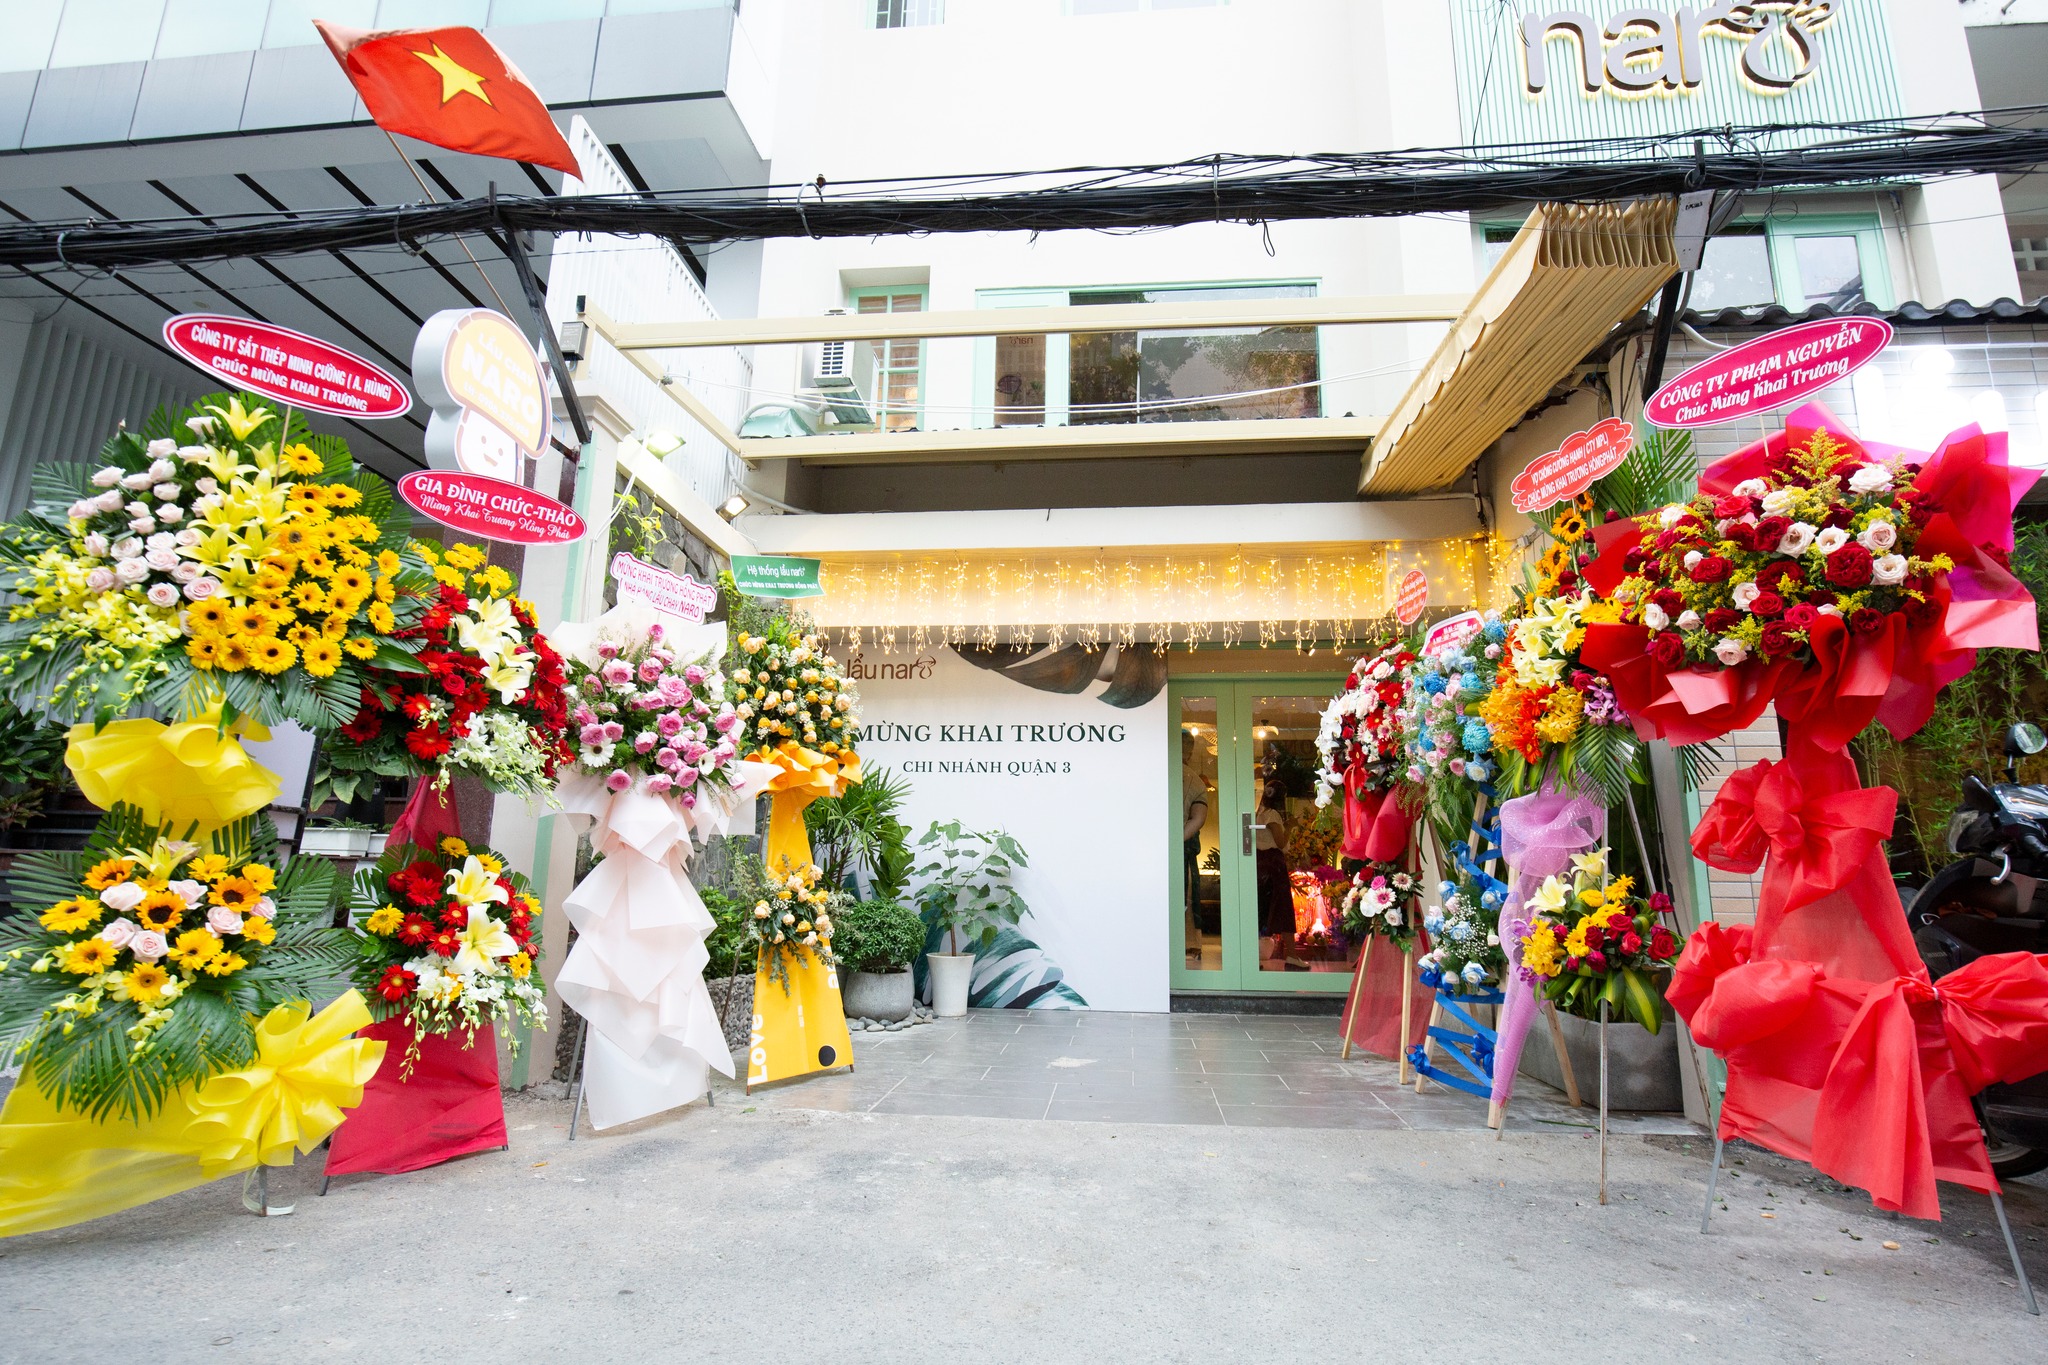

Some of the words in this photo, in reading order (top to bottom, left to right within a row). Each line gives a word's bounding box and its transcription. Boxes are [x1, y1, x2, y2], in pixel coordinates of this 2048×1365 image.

[191, 323, 220, 348] CÔNG
[223, 334, 237, 351] TY
[237, 335, 259, 359] SẮT
[260, 345, 287, 366] THÉP
[288, 354, 313, 375] MINH
[314, 363, 346, 385] CƯỜNG
[352, 377, 361, 390] A.
[1660, 382, 1703, 409] CÔNG
[1705, 373, 1729, 391] TY
[1730, 354, 1781, 386] PHẠM
[1785, 323, 1864, 367] NGUYỄN
[212, 355, 249, 376] CHÚC
[250, 365, 288, 388] MỪNG
[290, 378, 319, 396] KHAI
[322, 388, 368, 412] TRƯƠNG
[462, 342, 539, 424] NARO
[1675, 401, 1708, 423] Chúc
[1710, 388, 1750, 413] Mừng
[1753, 375, 1787, 400] Khai
[1791, 357, 1849, 385] Trương
[415, 476, 443, 496] GIA
[447, 481, 486, 506] ĐÌNH
[490, 496, 577, 527] CHỨC-THẢO
[454, 502, 480, 519] Khai
[519, 518, 545, 535] Hồng
[747, 565, 757, 576] Hệ
[758, 564, 779, 578] thống
[780, 564, 790, 576] lẩu
[679, 601, 699, 618] NARO
[857, 720, 932, 743] MỪNG
[939, 724, 1003, 743] KHAI
[1011, 721, 1126, 743] TRƯƠNG
[902, 760, 933, 773] CHI
[938, 759, 1002, 774] NHÁNH
[1007, 761, 1058, 778] QUẬN
[1062, 761, 1071, 774] 3
